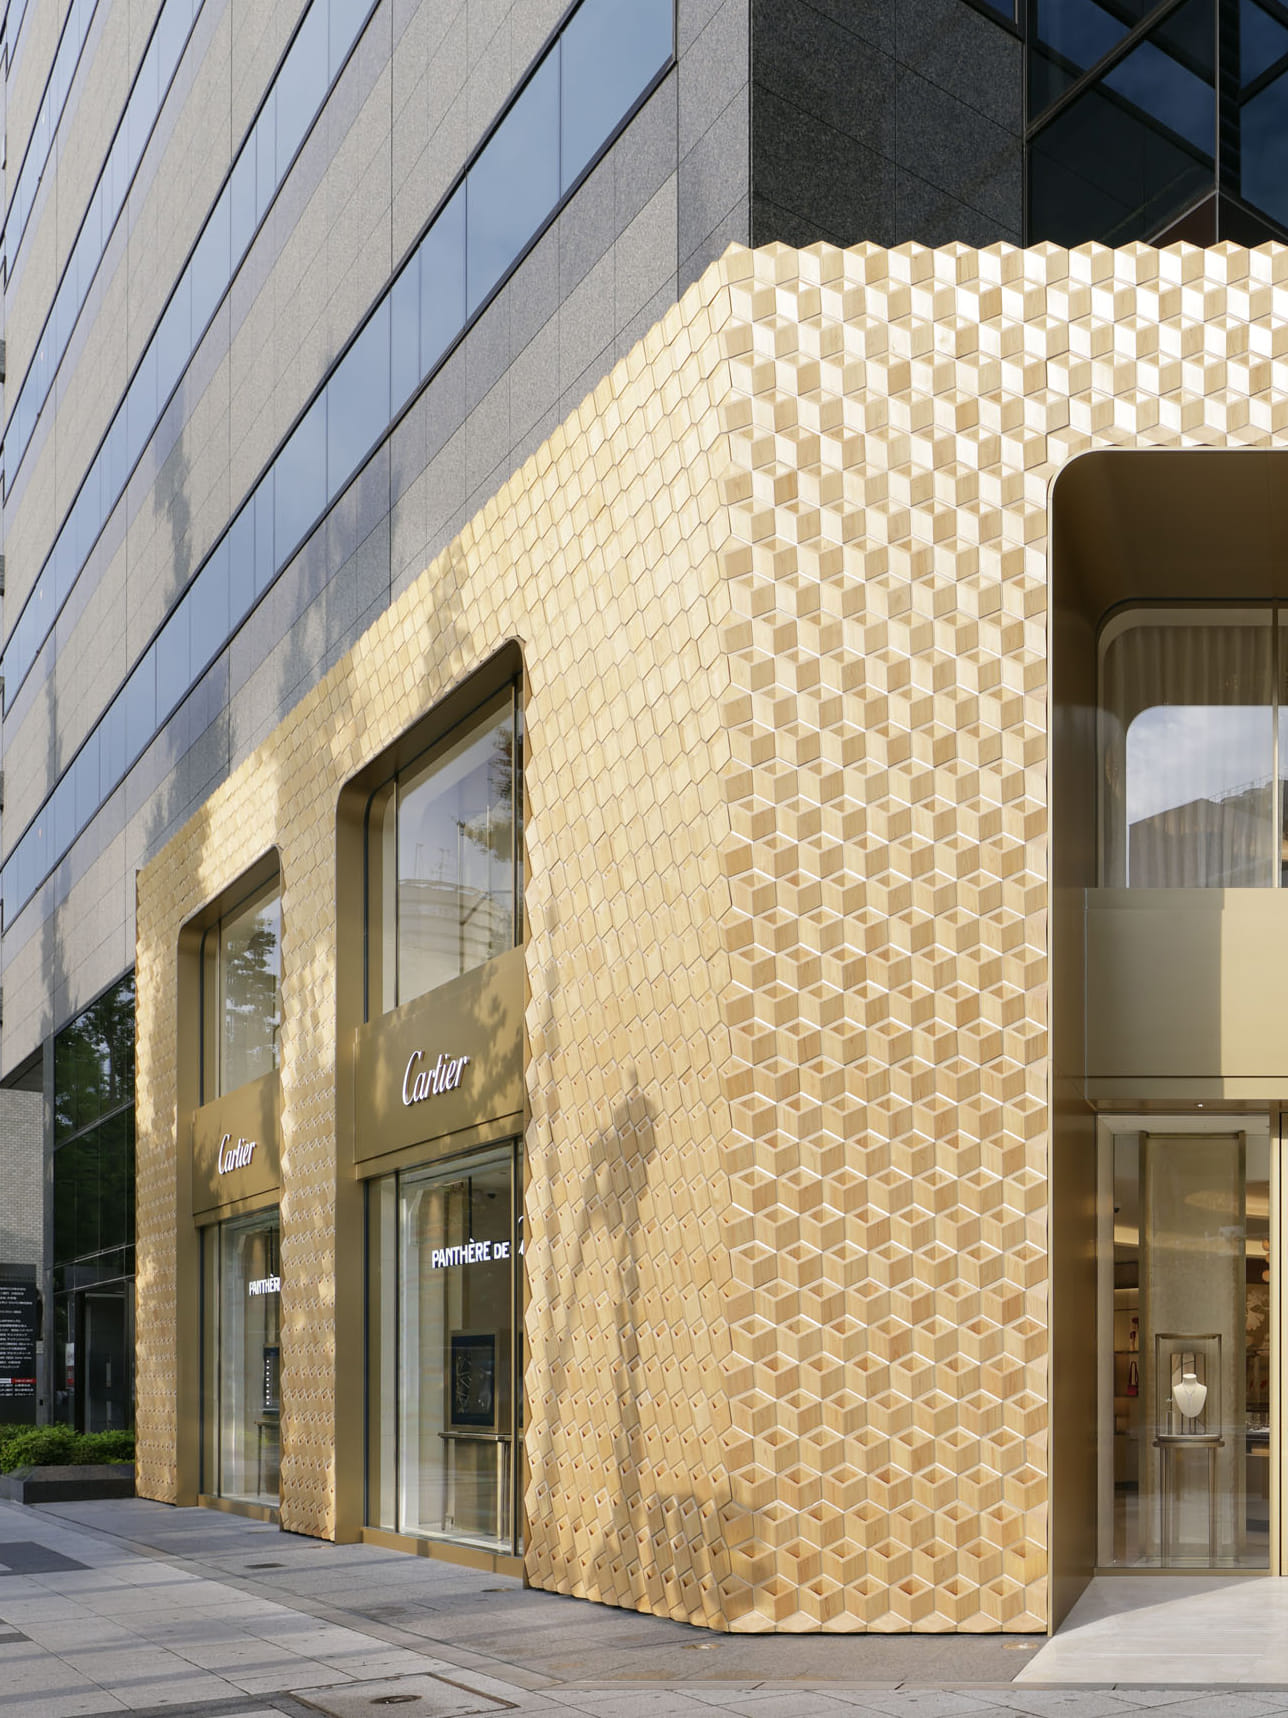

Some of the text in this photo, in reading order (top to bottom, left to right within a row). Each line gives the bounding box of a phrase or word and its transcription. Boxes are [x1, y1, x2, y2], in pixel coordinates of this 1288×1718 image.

[402, 1050, 469, 1106] Cartier
[218, 1133, 257, 1175] Cartier
[431, 1237, 510, 1269] PANTHÈRE DE
